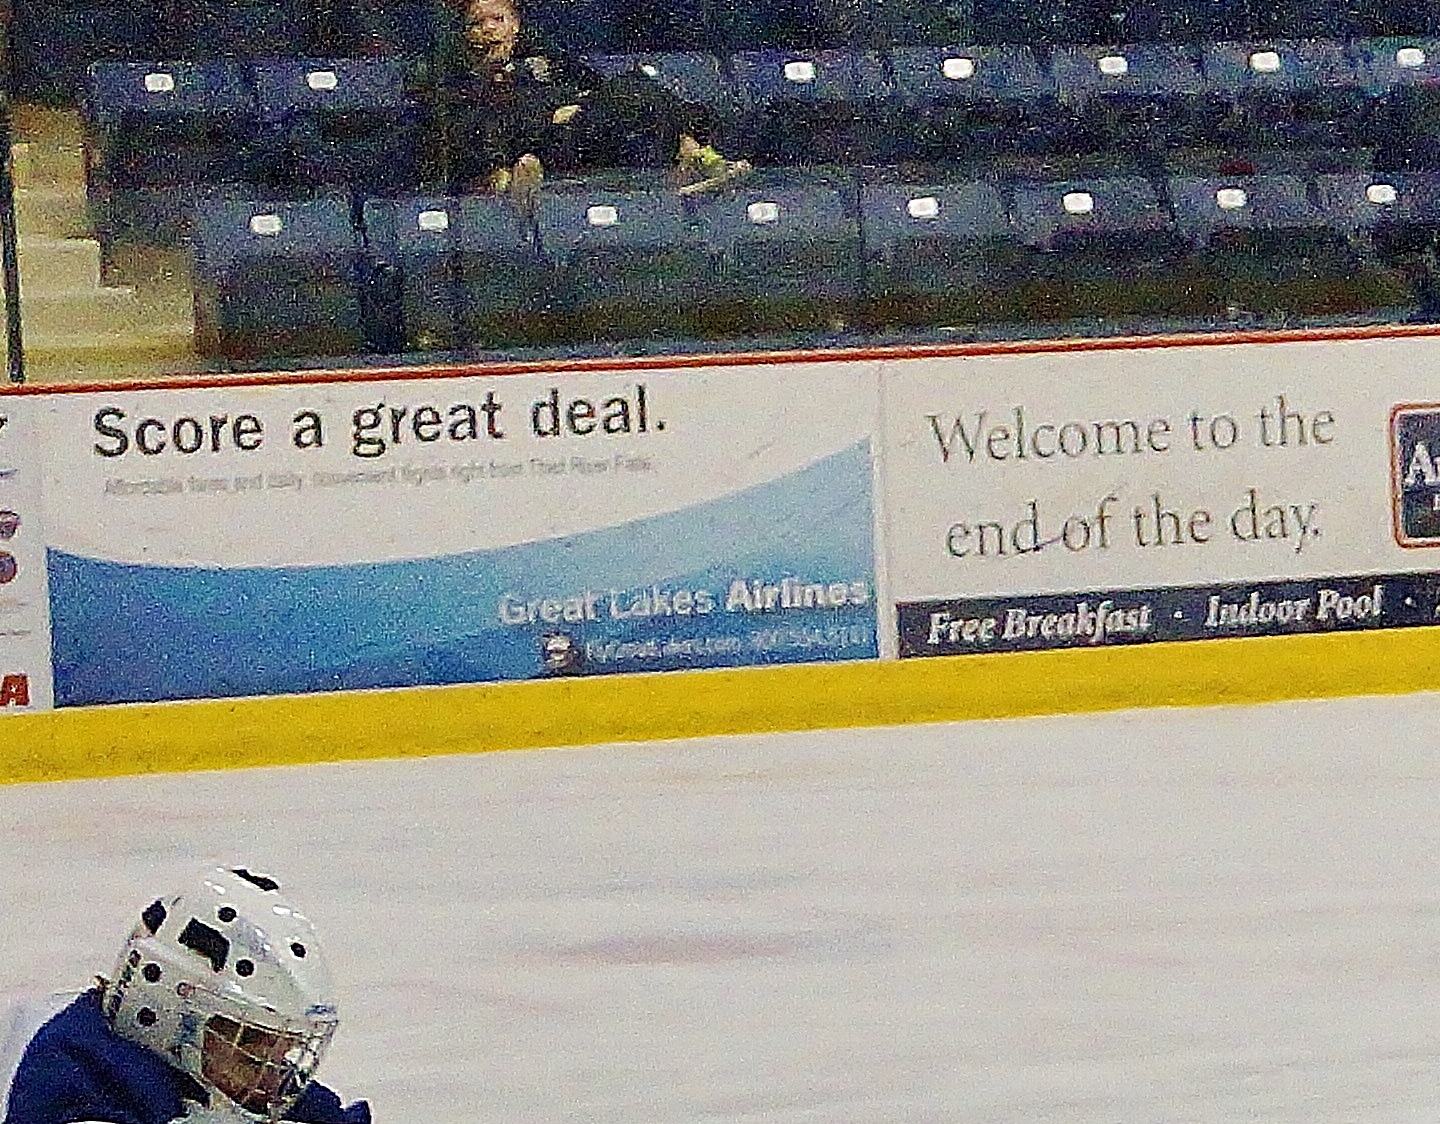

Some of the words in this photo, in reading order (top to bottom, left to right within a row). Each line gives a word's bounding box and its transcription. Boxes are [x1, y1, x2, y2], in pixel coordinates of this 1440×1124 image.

[92, 406, 264, 459] Score
[291, 407, 324, 450] a
[351, 391, 506, 458] great
[532, 385, 667, 438] deal.
[926, 407, 1172, 464] Welcome
[1190, 409, 1241, 453] to
[1260, 395, 1336, 448] the
[945, 499, 1045, 560] end
[1061, 488, 1119, 551] of
[1135, 494, 1210, 548] the
[1229, 487, 1323, 557] day.
[501, 589, 599, 626] Great
[610, 584, 715, 619] Lakes
[725, 576, 871, 612] Airlines
[927, 610, 996, 645] Free
[1003, 601, 1153, 648] Breakfast
[1205, 592, 1313, 628] Indoor
[1317, 583, 1384, 623] Pool
